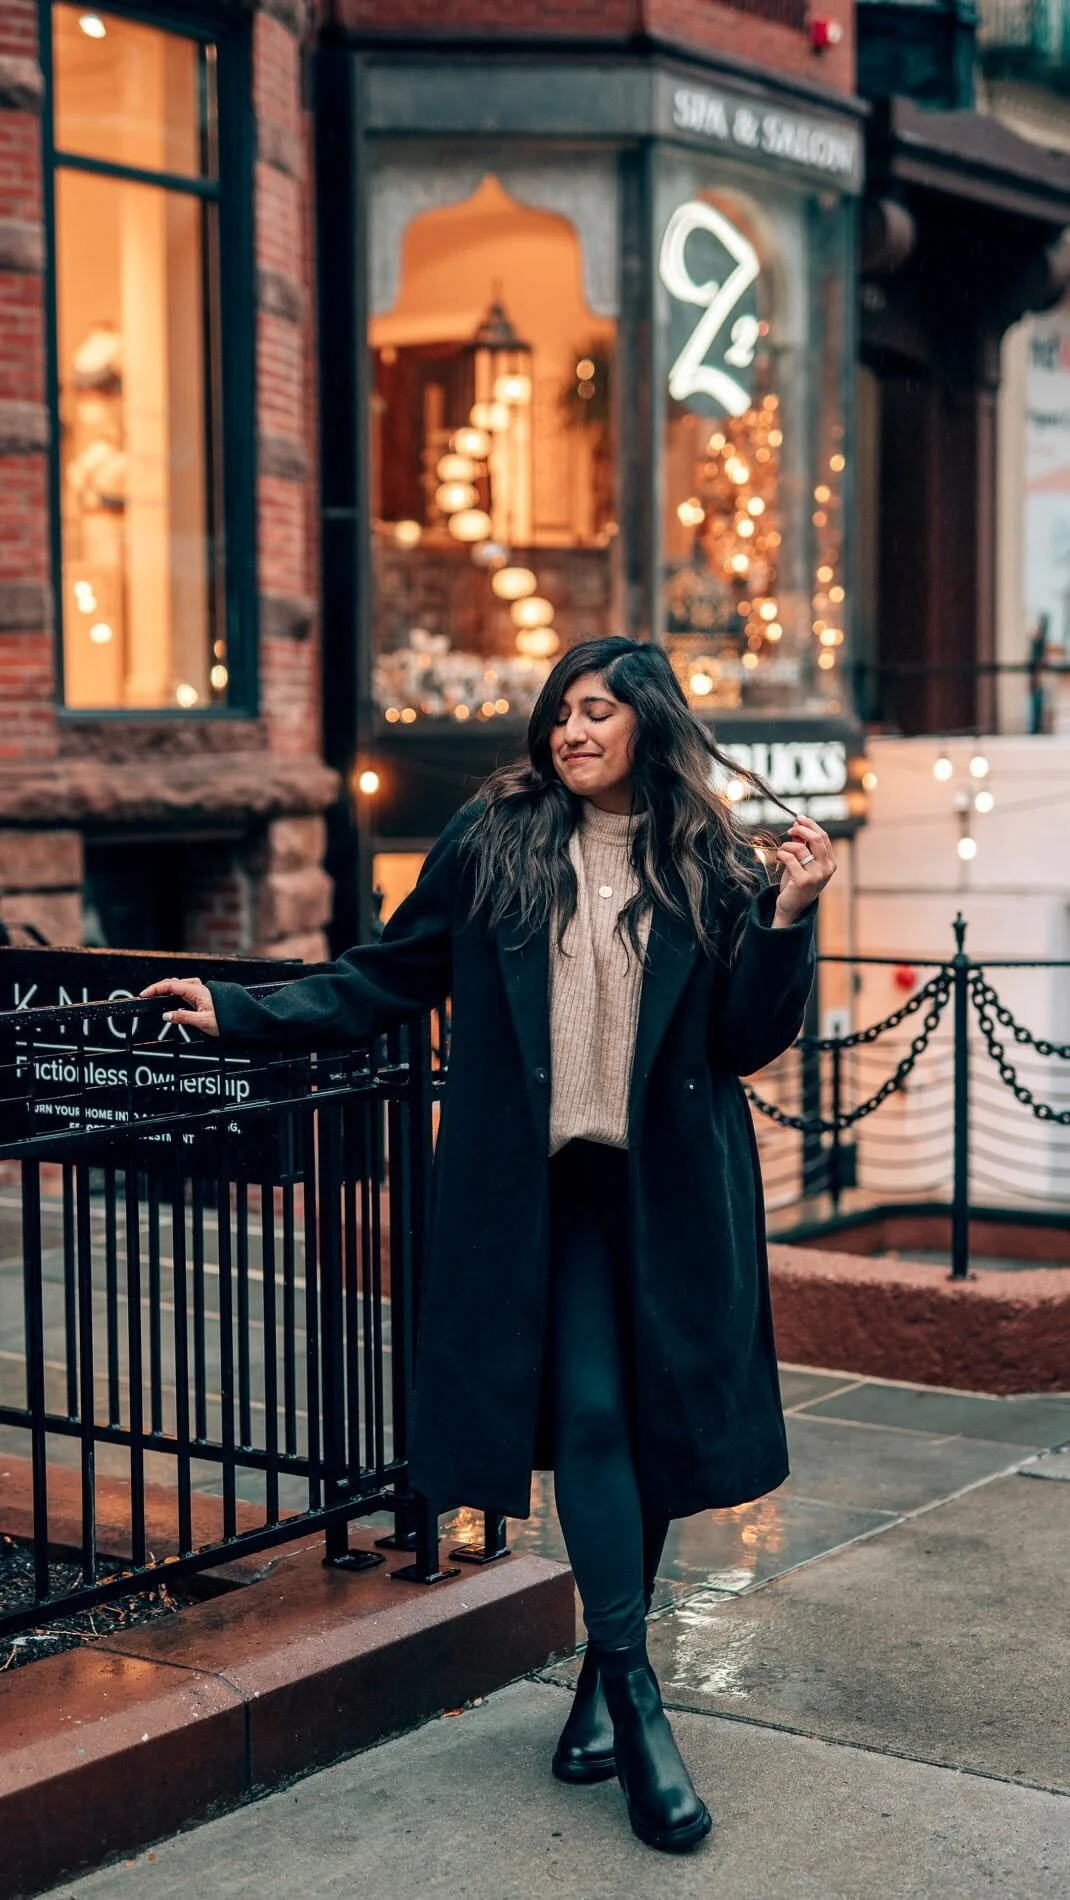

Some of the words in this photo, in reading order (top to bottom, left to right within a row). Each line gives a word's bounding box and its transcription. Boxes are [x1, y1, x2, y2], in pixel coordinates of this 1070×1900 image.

[673, 89, 728, 139] SPA
[732, 108, 760, 147] &
[761, 115, 855, 175] SALON
[16, 1056, 128, 1086] Fictionless
[54, 1105, 80, 1117] YOUR
[85, 1107, 113, 1121] HOME
